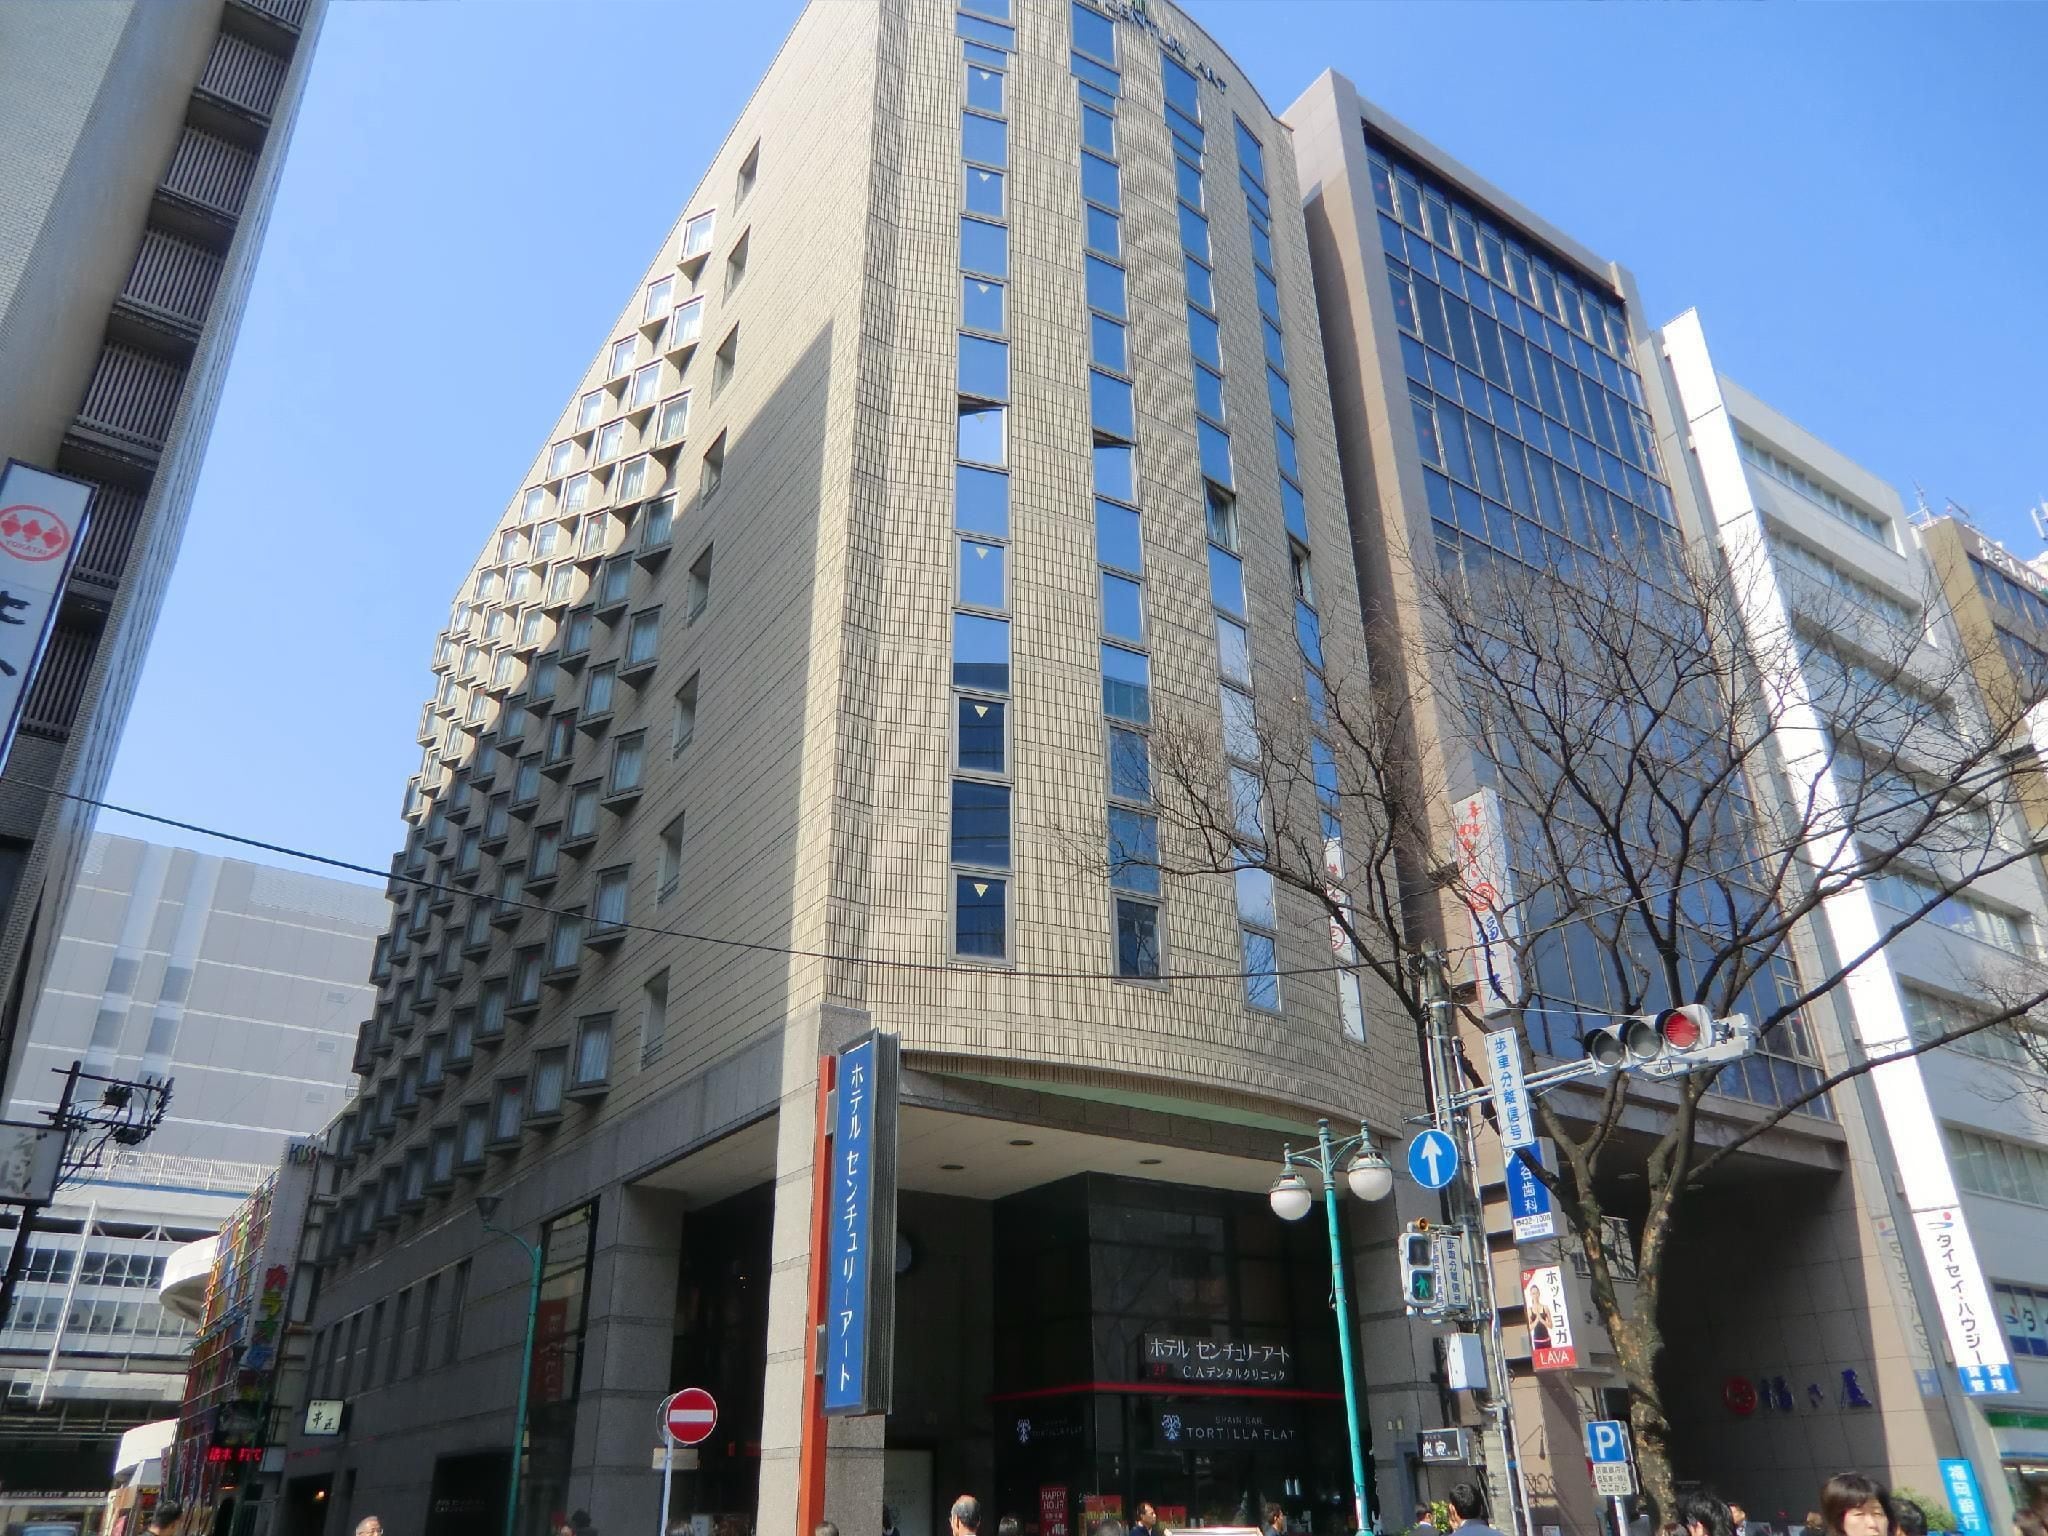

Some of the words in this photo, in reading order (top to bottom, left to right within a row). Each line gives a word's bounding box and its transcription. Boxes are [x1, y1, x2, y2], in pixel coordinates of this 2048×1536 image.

[849, 1062, 864, 1141] ホテル
[1494, 1037, 1523, 1141] 歩車分離信号
[1519, 1157, 1538, 1214] 谷歯科
[840, 1149, 860, 1393] センチュリーアート
[1545, 1270, 1569, 1344] ホットヨガ
[1150, 1337, 1190, 1359] ホテル
[1196, 1341, 1290, 1364] センチュリーアート
[1540, 1351, 1570, 1365] LAVA
[1186, 1426, 1259, 1440] TORTILLA
[1264, 1429, 1295, 1440] FLAT
[1596, 1425, 1616, 1459] P
[1041, 1491, 1066, 1502] HAPPY
[1948, 1465, 1980, 1530] 福岡銀行
